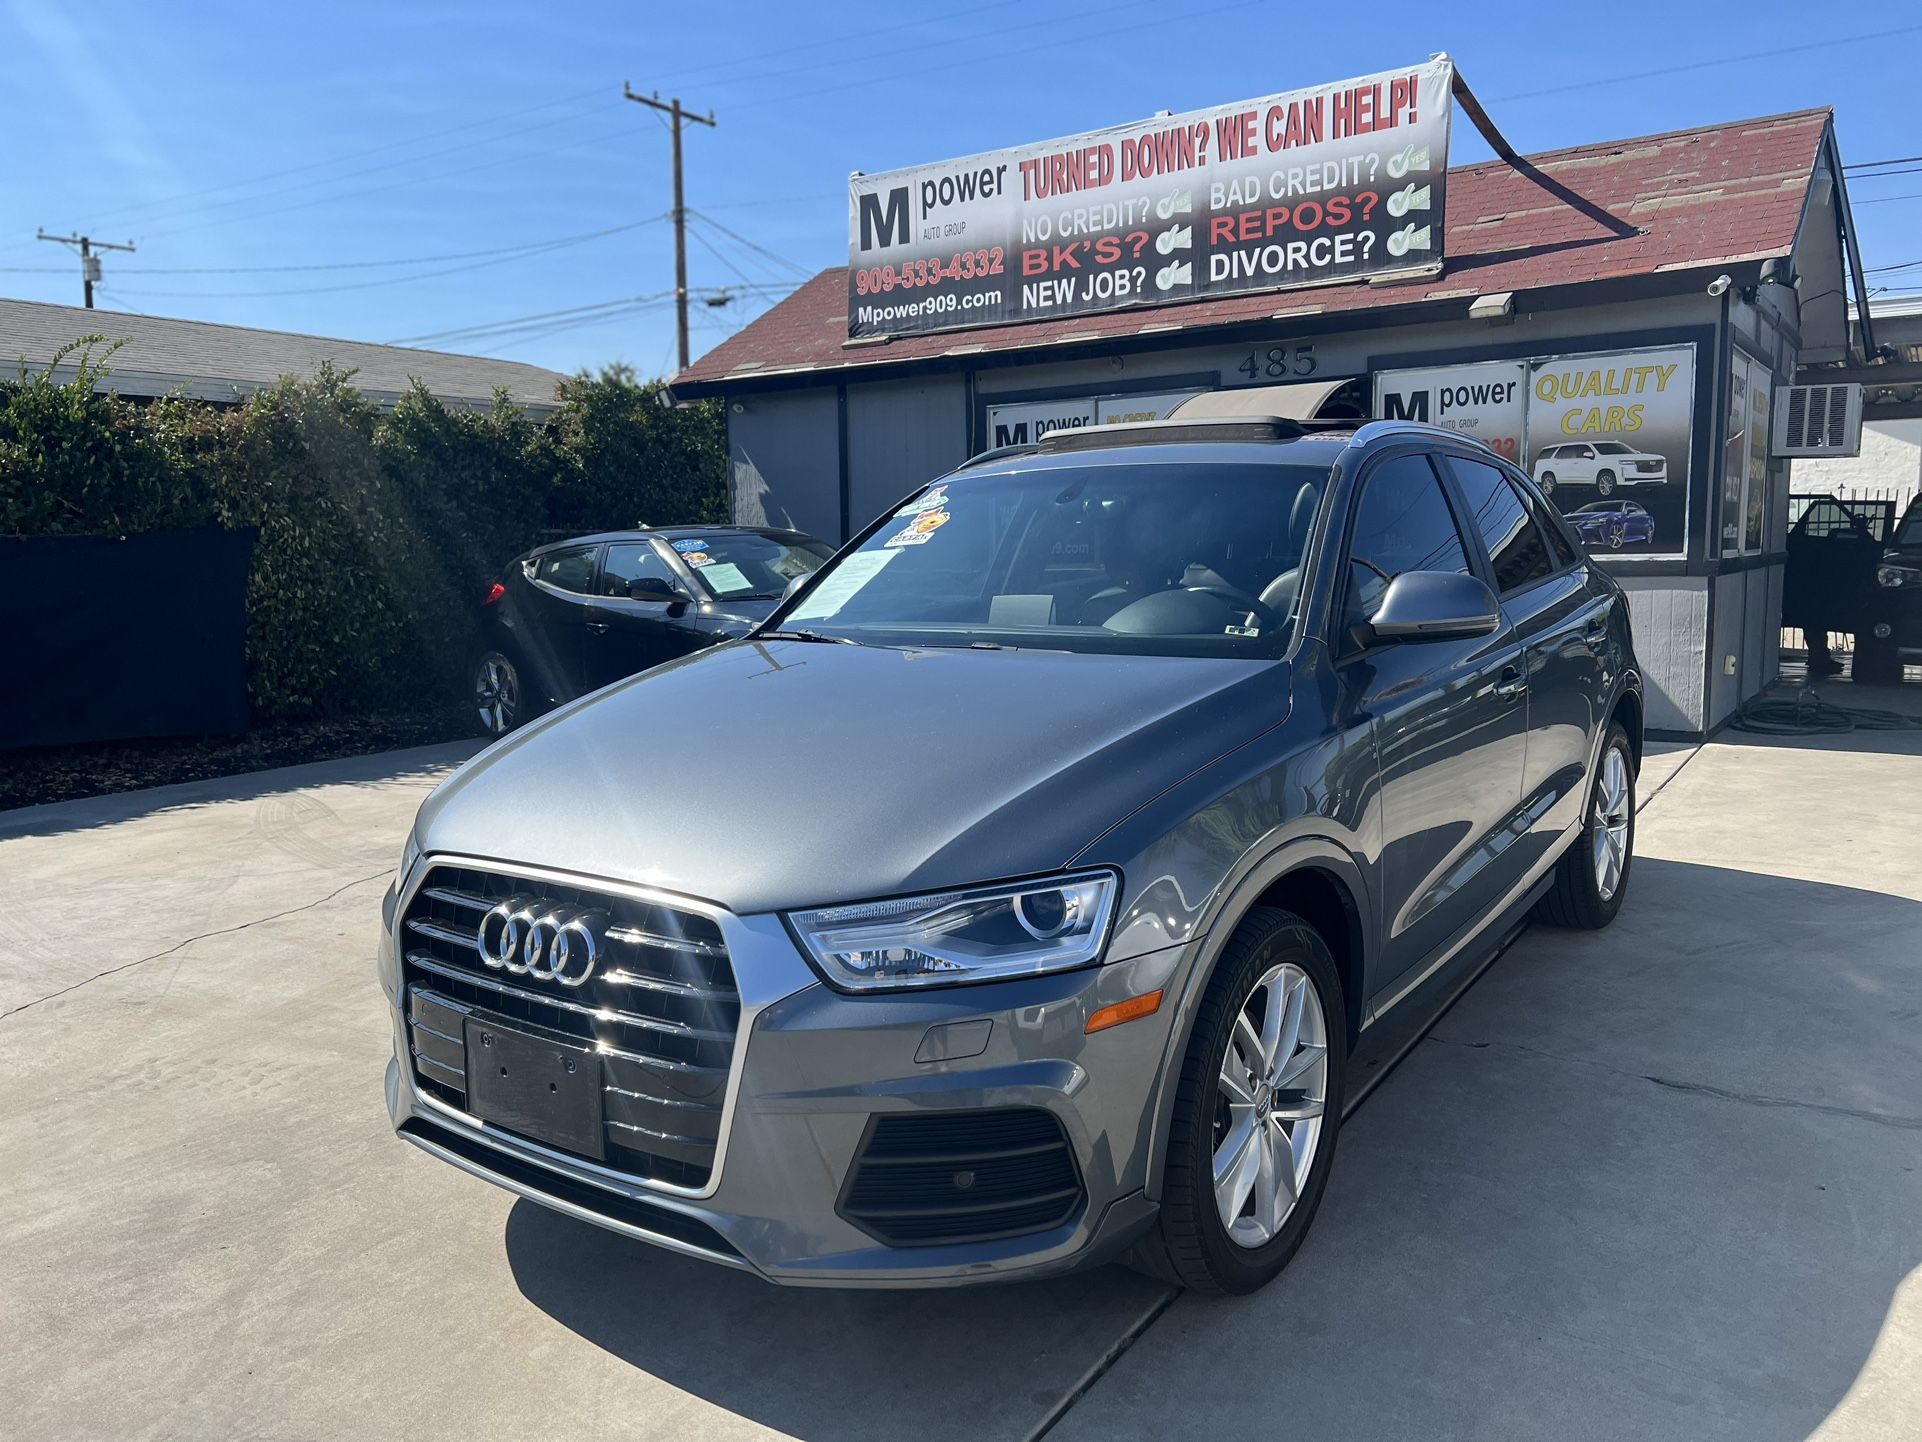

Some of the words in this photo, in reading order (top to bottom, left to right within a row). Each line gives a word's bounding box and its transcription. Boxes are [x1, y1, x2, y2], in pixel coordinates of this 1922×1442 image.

[1019, 143, 1115, 201] TURNED
[1121, 121, 1210, 182] DOWN?
[1216, 110, 1258, 163] WE
[1265, 95, 1324, 153] CAN
[1332, 74, 1419, 141] HELP!
[1210, 174, 1261, 211] BAD
[1268, 152, 1380, 200] CREDIT?
[859, 186, 910, 251] M
[921, 164, 1007, 220] power
[1022, 214, 1052, 244] NO
[1058, 196, 1150, 238] CREDIT?
[1210, 191, 1379, 246] REPOS?
[923, 225, 940, 240] AUTO
[944, 221, 966, 237] GROUP
[856, 246, 1004, 296] 909-533-4332
[1022, 231, 1150, 277] BK'S?
[1210, 230, 1376, 282] DIVORCE?
[858, 290, 1002, 325] Mpower909.com
[1022, 276, 1076, 310] NEW
[1081, 266, 1146, 302] JOB?
[1238, 345, 1318, 379] 485
[1535, 363, 1678, 404] QUALITY
[1440, 381, 1517, 415] power
[1560, 404, 1645, 435] CARS
[1459, 418, 1479, 429] GROUP
